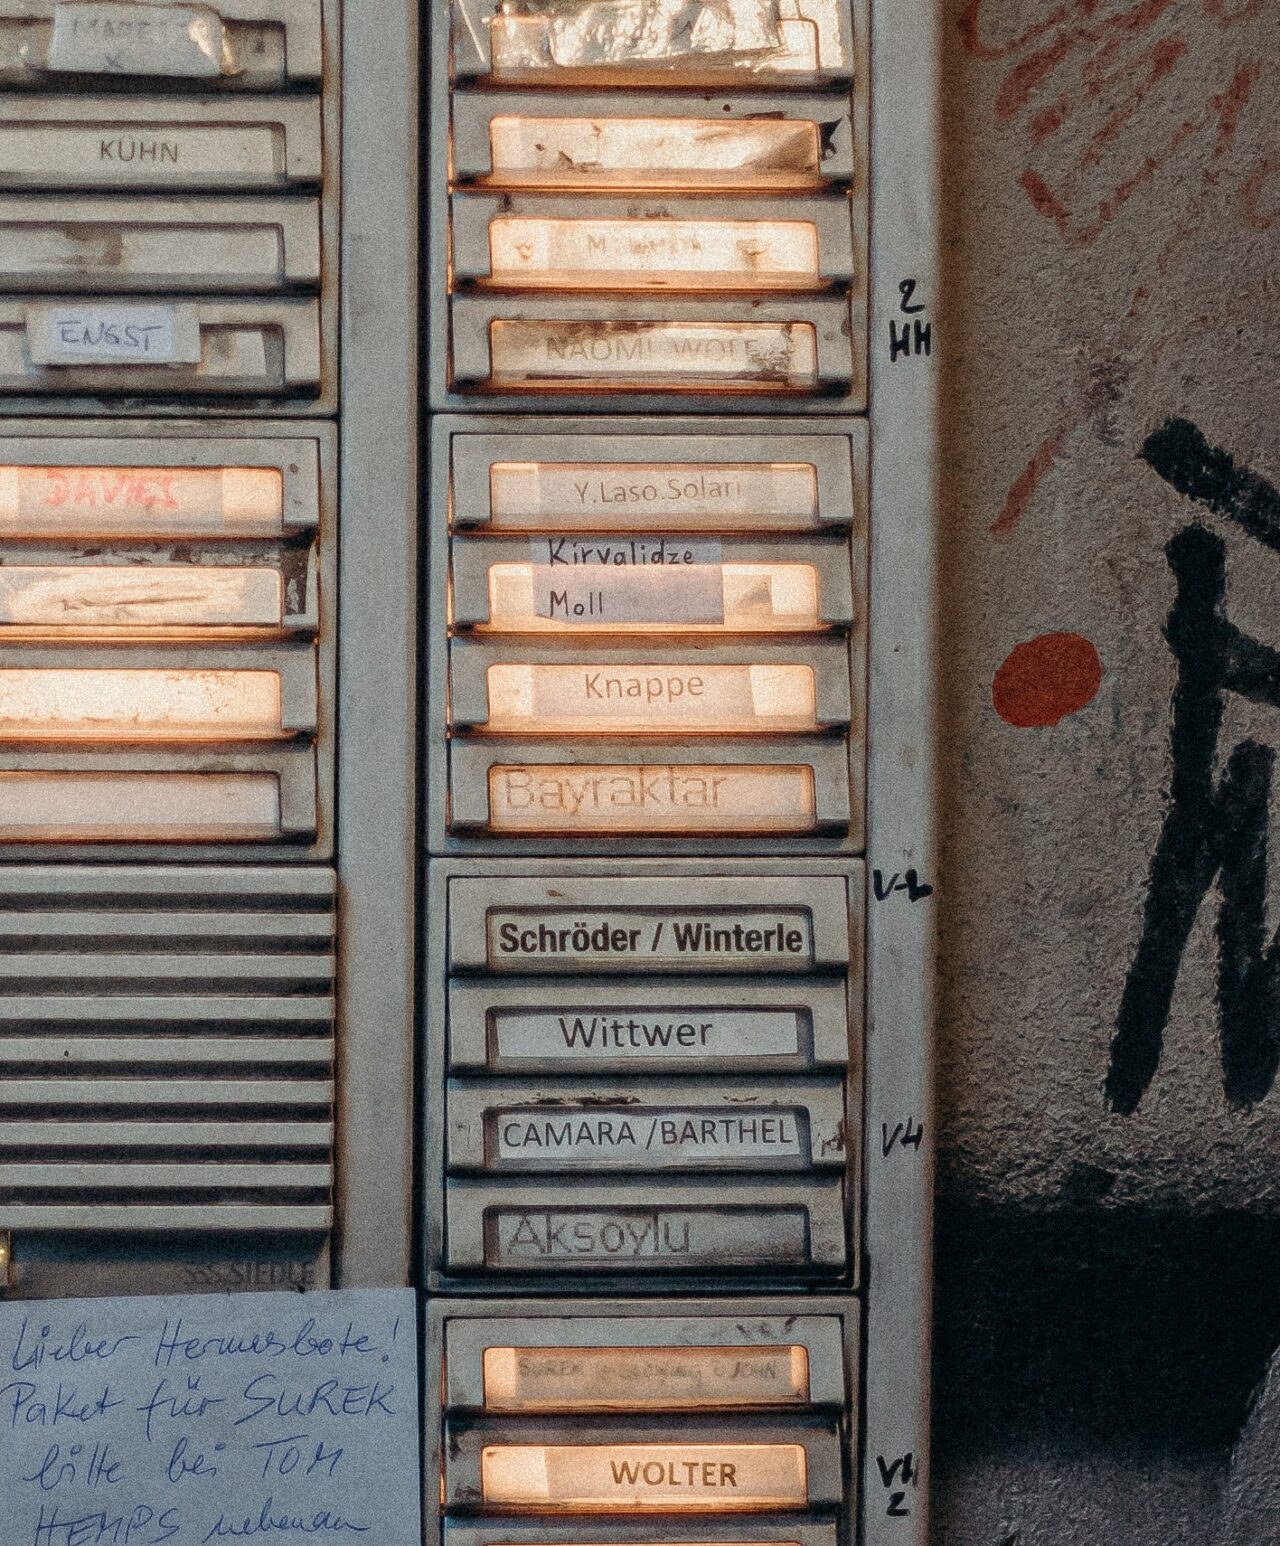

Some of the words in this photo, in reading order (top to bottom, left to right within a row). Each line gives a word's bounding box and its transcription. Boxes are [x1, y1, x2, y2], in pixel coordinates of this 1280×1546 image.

[899, 279, 925, 314] 2
[57, 320, 163, 352] ENGST
[546, 336, 652, 362] NAOMI
[548, 538, 694, 567] Kirvalidze
[549, 590, 603, 617] Moll
[584, 672, 705, 703] Knappe
[506, 767, 726, 816] Bayraktar
[499, 922, 641, 953] Schröder
[651, 922, 663, 952] /
[673, 922, 803, 953] Winterle
[558, 1017, 712, 1047] Wittwer
[503, 1121, 636, 1147] CAMARA
[645, 1118, 793, 1150] /BARTHEL
[509, 1214, 690, 1255] Aksoylu
[228, 1260, 316, 1286] SIEDLE
[12, 1317, 136, 1370] Lieber
[155, 1318, 399, 1366] Hermesbote!
[137, 1376, 222, 1441] für
[23, 1443, 123, 1490] bitte
[166, 1437, 226, 1484] bei
[253, 1434, 343, 1478] TOM
[610, 1460, 737, 1487] WOLTER
[886, 1491, 910, 1517] 2
